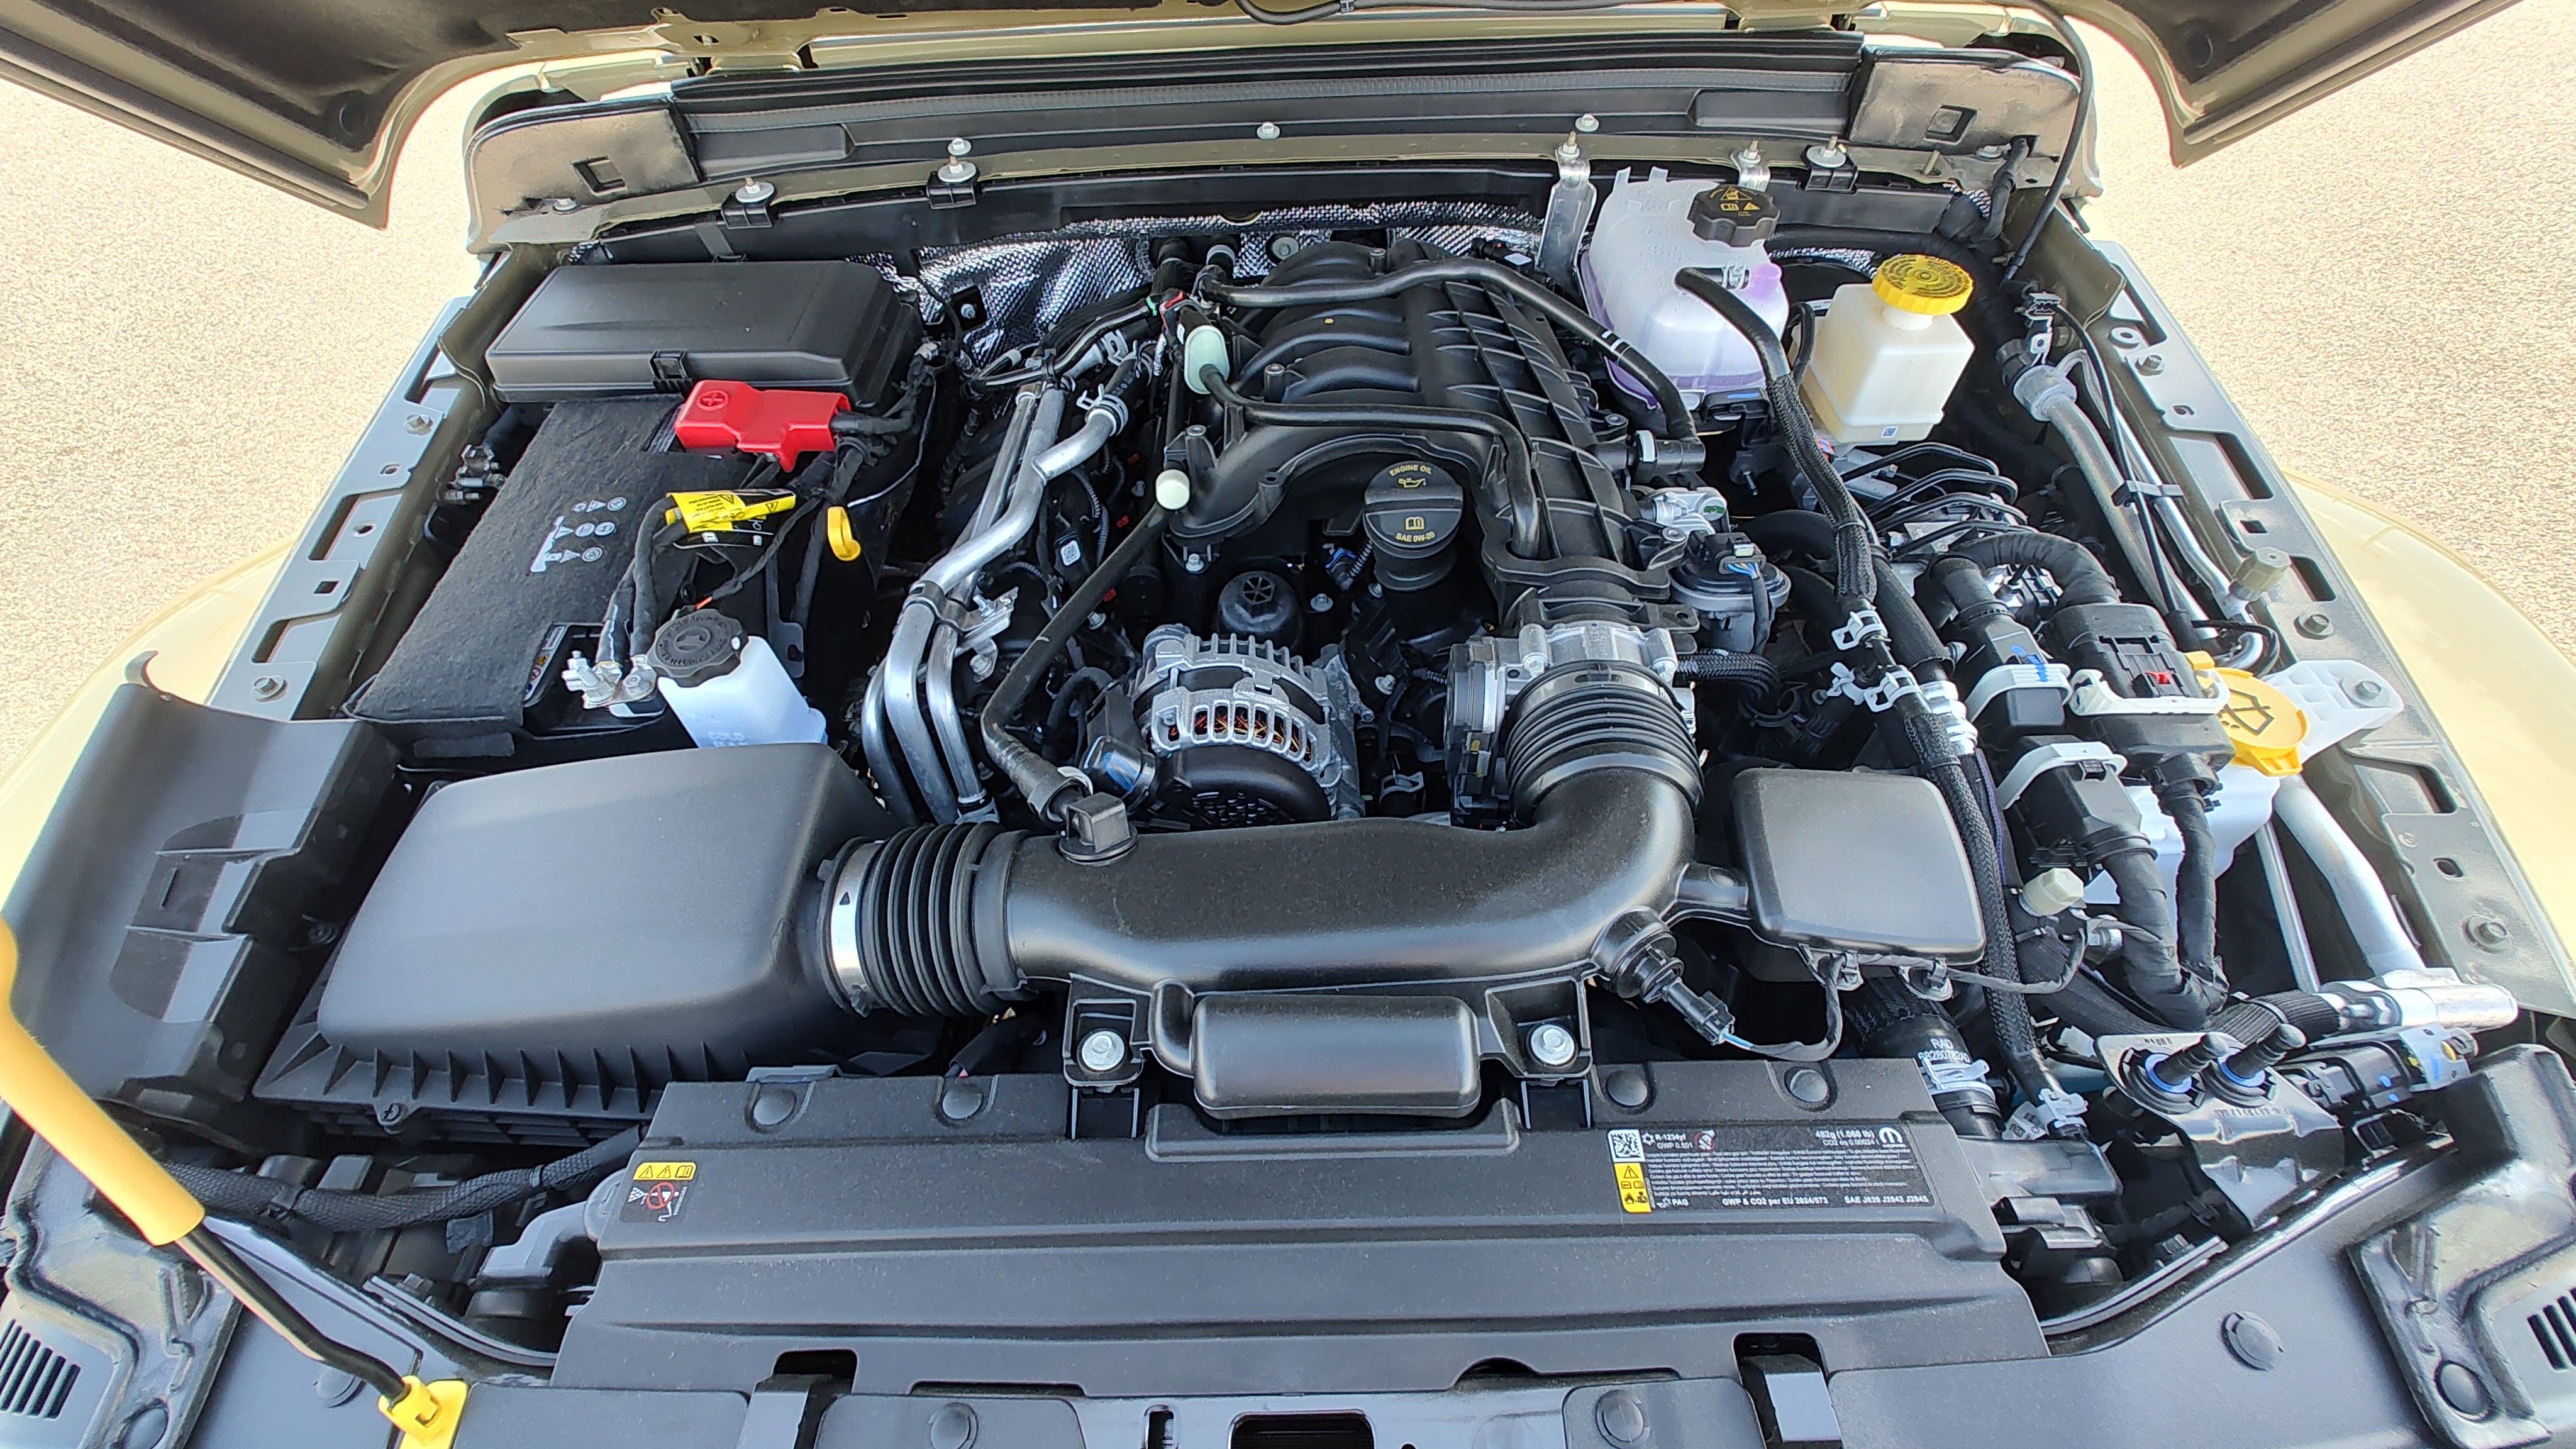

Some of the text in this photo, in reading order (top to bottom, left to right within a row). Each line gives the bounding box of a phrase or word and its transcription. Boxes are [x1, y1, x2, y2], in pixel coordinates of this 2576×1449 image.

[1389, 465, 1432, 477] ENGINE OIL
[1396, 531, 1435, 542] SAE 0W-20
[1930, 1038, 1953, 1049] RAD
[1815, 1130, 1836, 1139] 482g
[1862, 1130, 1875, 1139] lb)
[1795, 1197, 1828, 1205] 2024/573
[1844, 1196, 1861, 1204] SAE
[1862, 1196, 1881, 1204] J639
